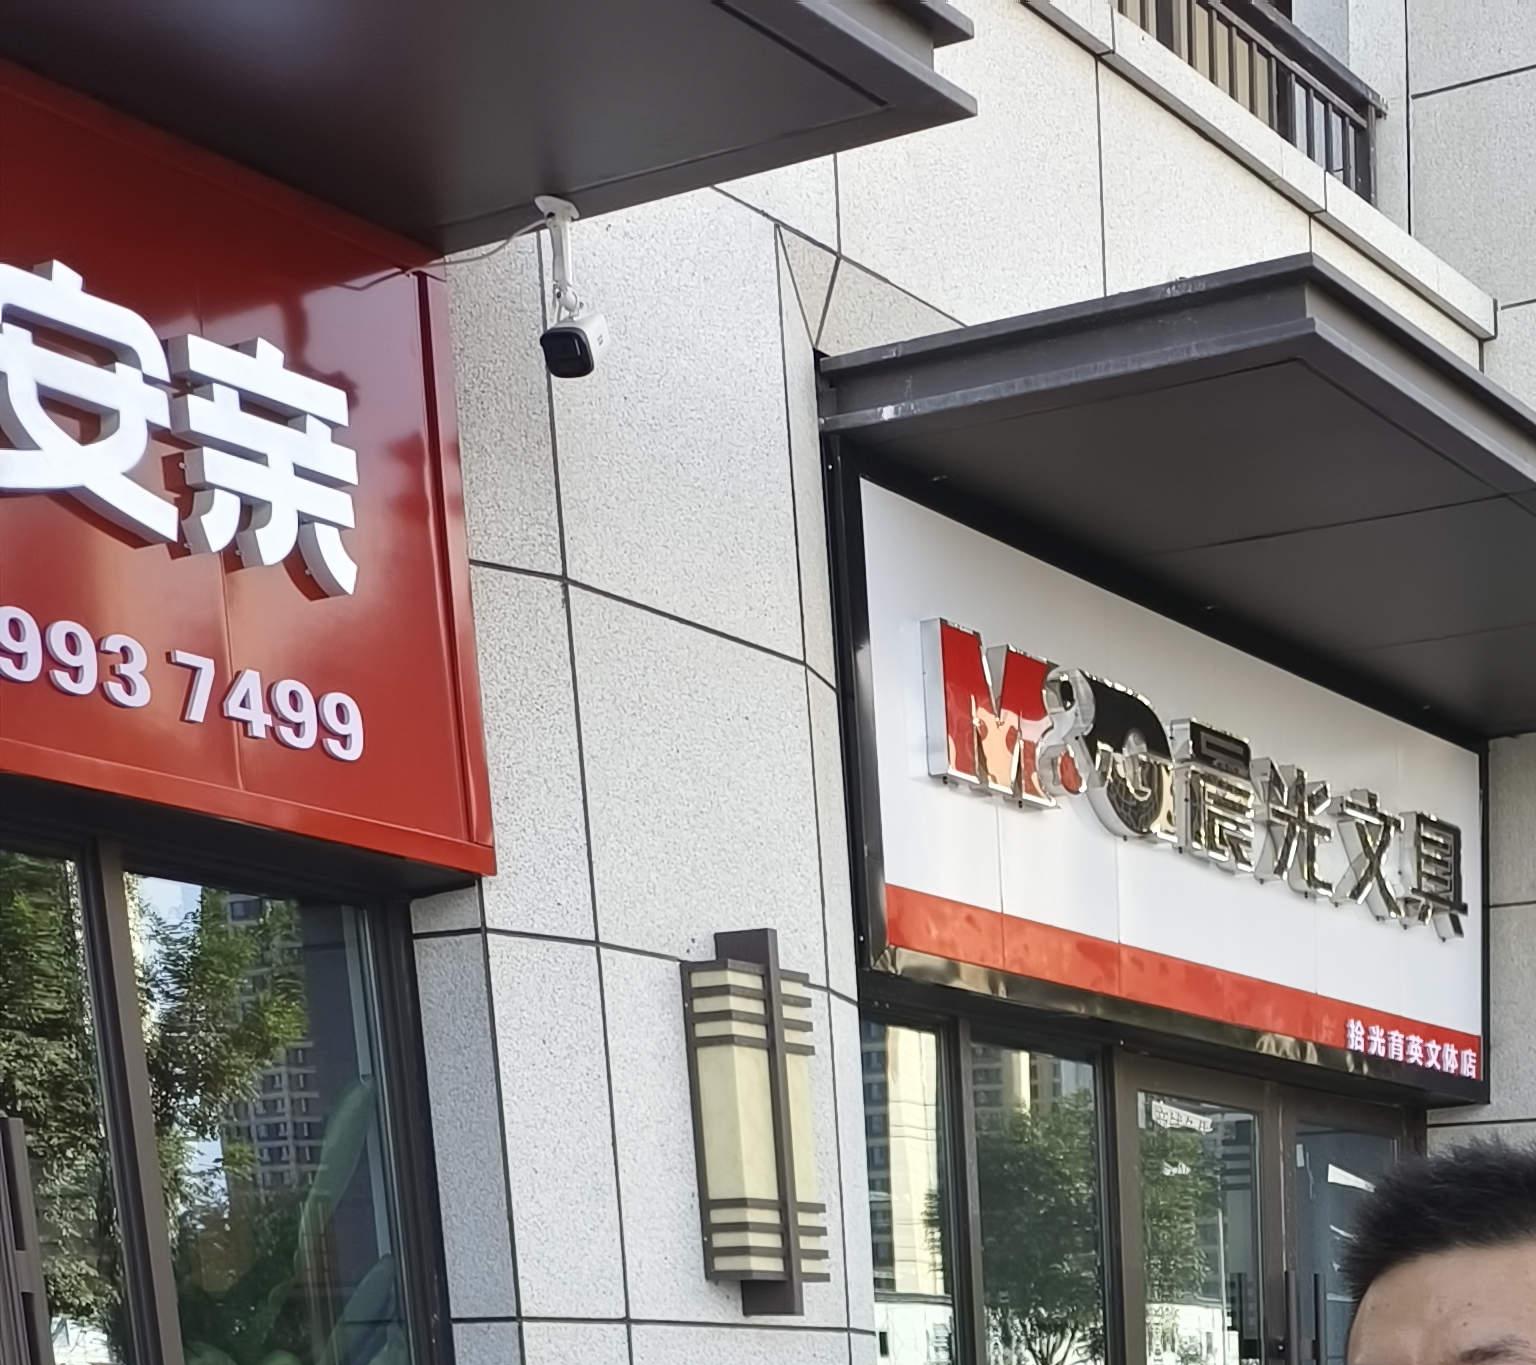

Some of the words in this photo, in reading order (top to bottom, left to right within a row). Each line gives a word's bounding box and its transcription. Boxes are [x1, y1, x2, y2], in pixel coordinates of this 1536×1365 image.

[0, 605, 151, 708] 993
[168, 648, 364, 762] 7499
[1172, 718, 1468, 942] 晨光文具
[1345, 1018, 1477, 1079] 拾光育英文体店
